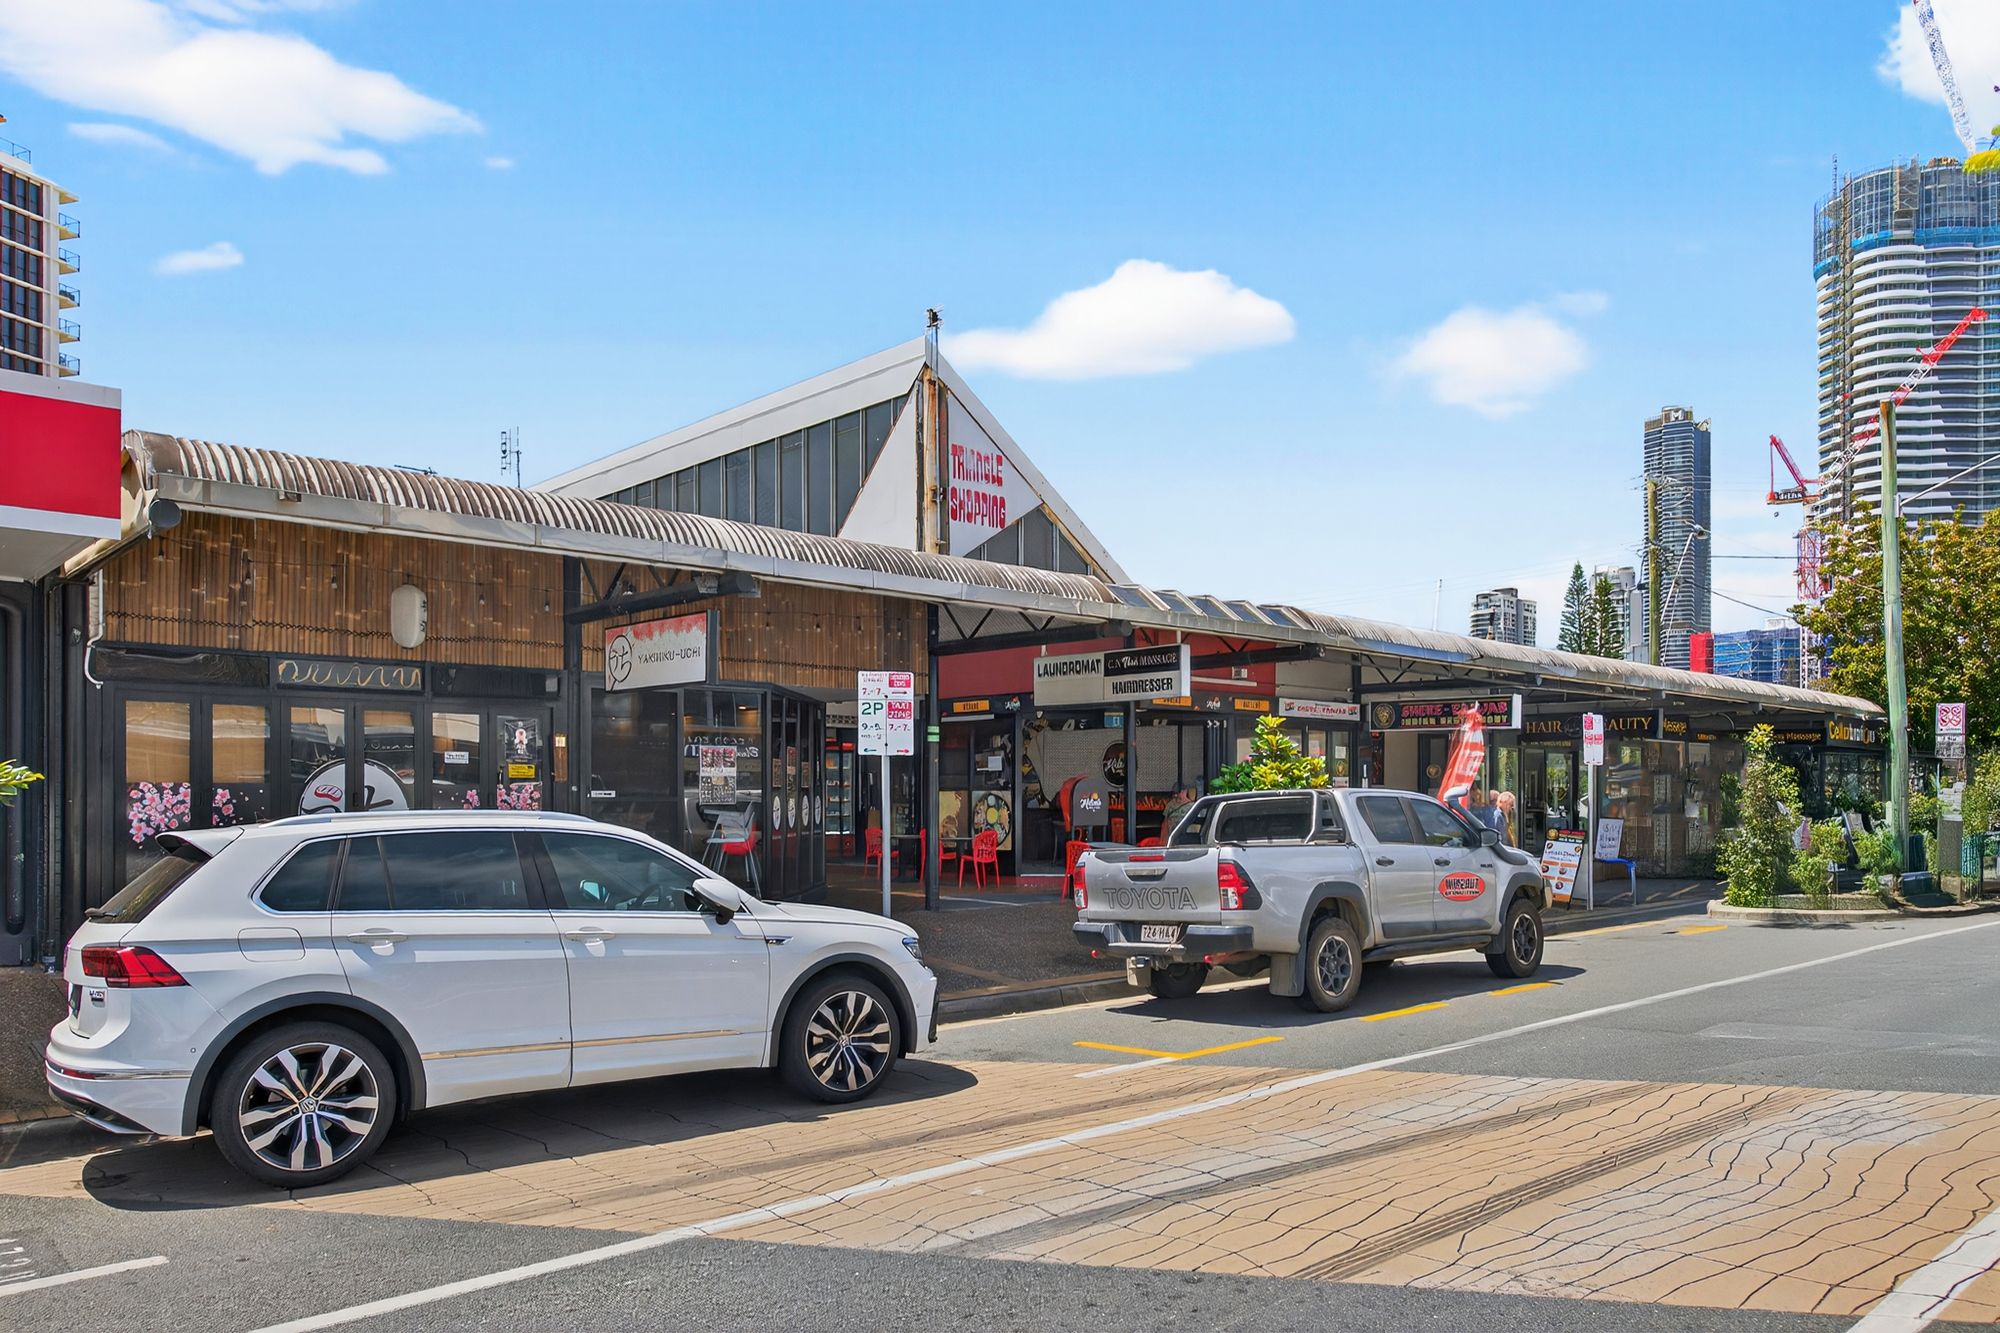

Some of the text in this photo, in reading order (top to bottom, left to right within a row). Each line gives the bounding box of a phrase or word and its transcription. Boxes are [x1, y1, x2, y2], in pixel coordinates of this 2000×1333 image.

[951, 443, 1003, 487] TRIANGLE
[950, 486, 1006, 529] SHOPPING
[1038, 659, 1101, 678] LAUNDROMAT
[1112, 677, 1173, 695] HAIRDRESSER
[861, 702, 884, 716] 2P
[1526, 720, 1562, 734] HAIR
[1103, 886, 1198, 910] TOYOTA
